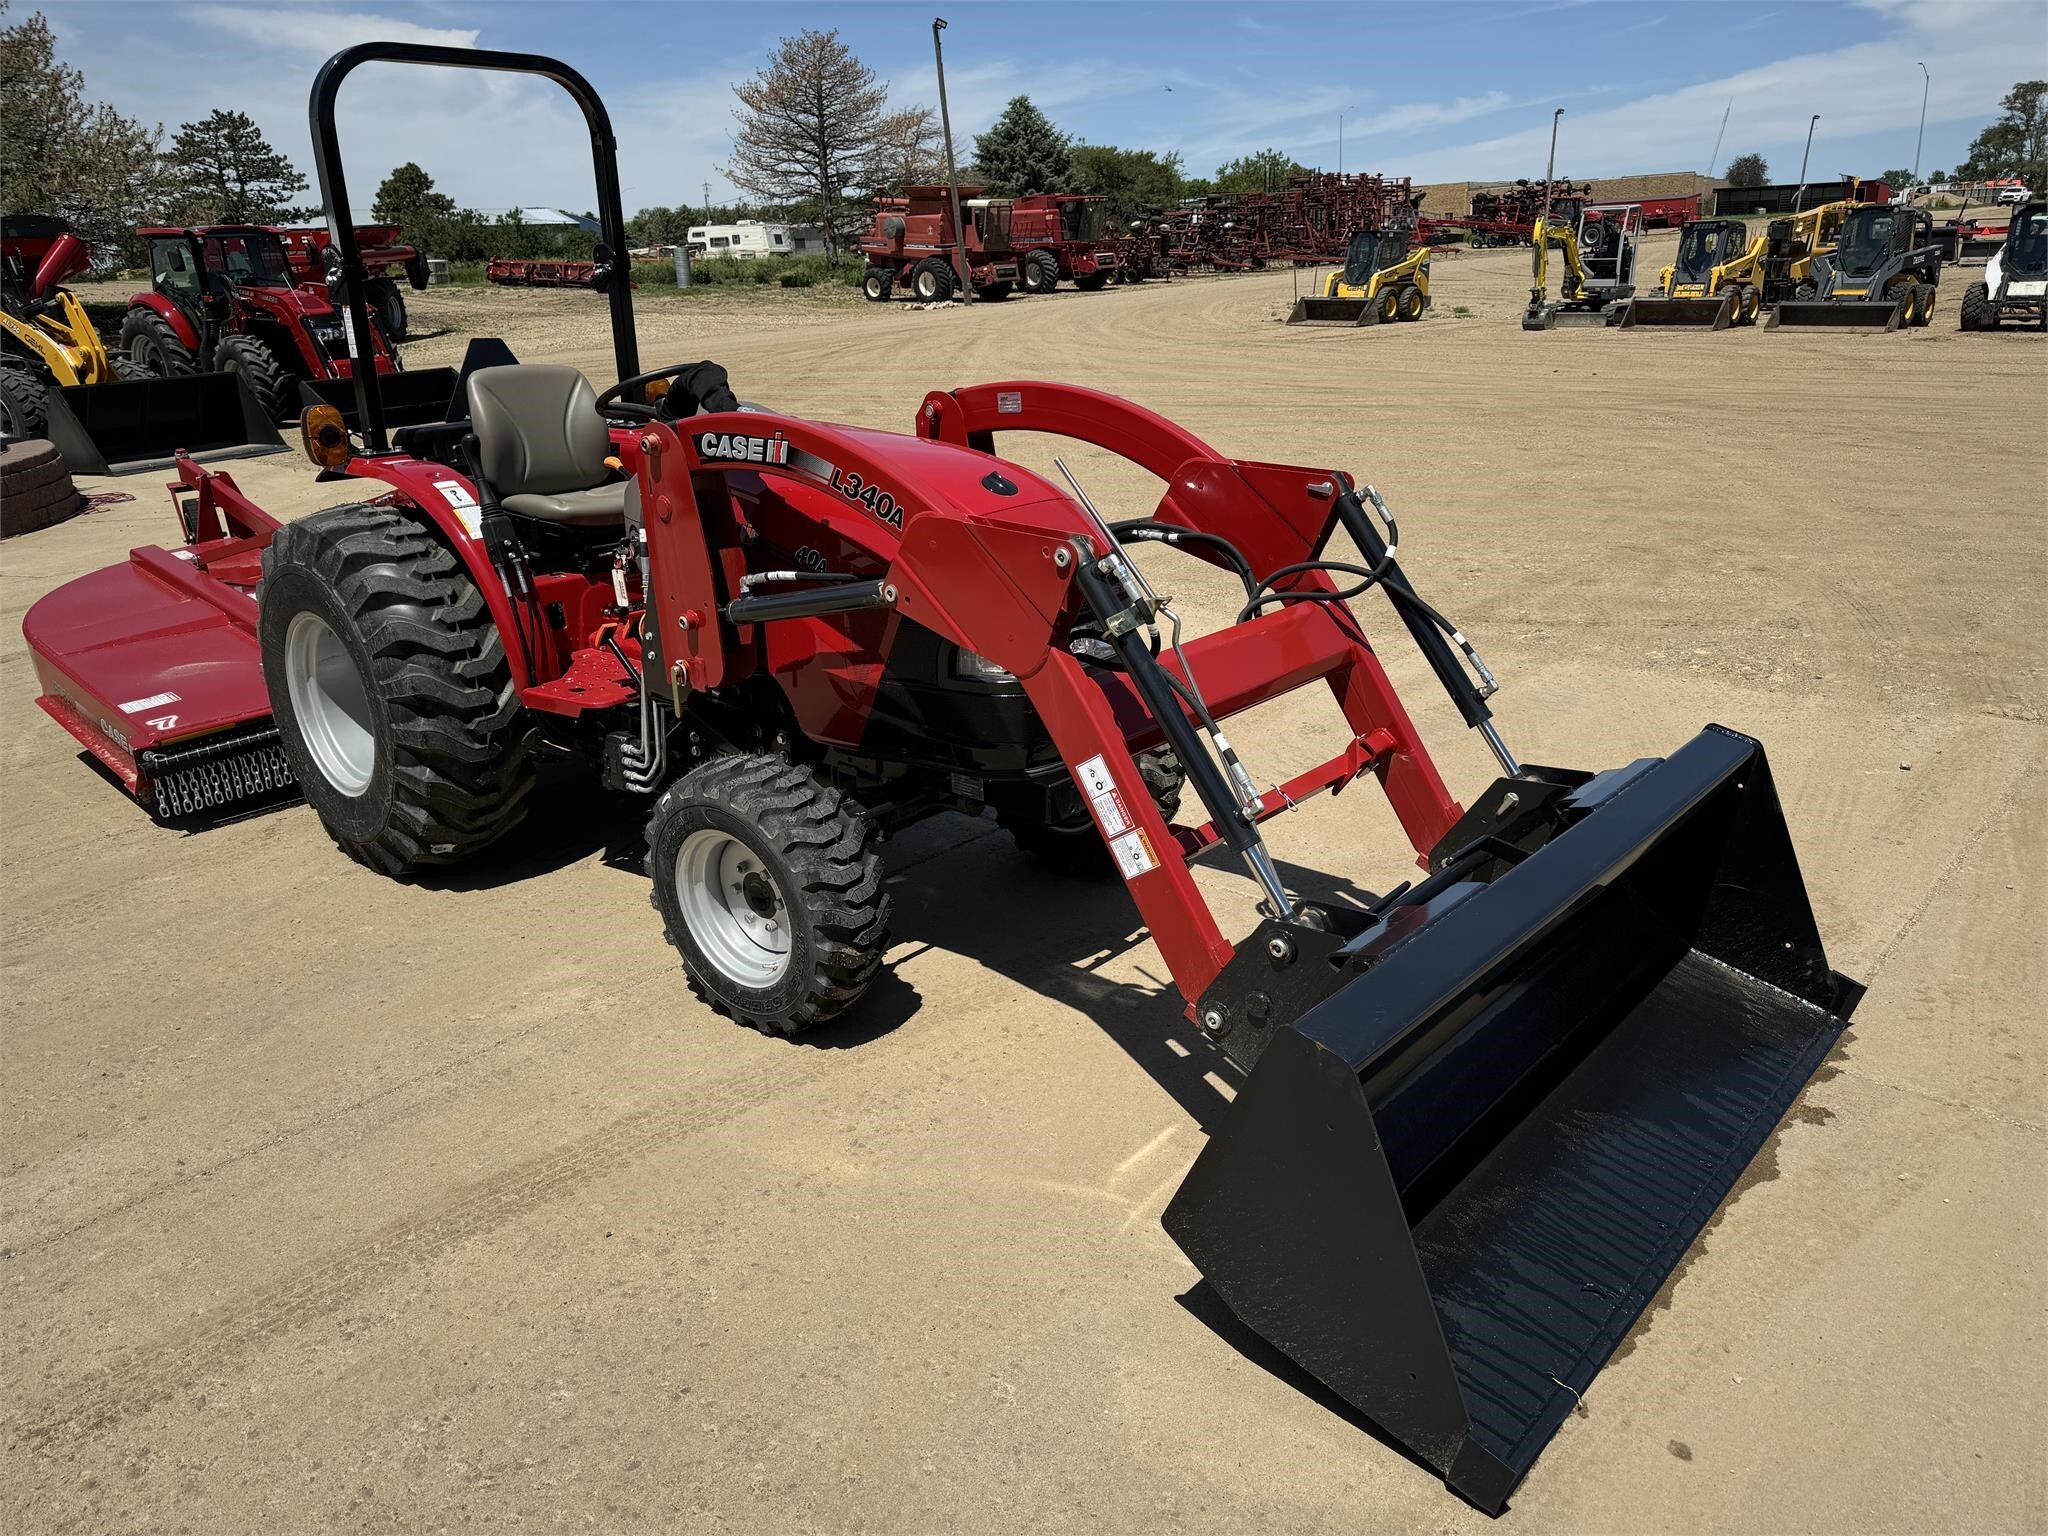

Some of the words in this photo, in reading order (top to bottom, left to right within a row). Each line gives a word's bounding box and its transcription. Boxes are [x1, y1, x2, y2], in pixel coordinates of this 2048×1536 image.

[24, 333, 46, 356] GEHL
[701, 432, 765, 463] CASE
[830, 467, 905, 531] L340A
[1115, 798, 1131, 826] DANGER
